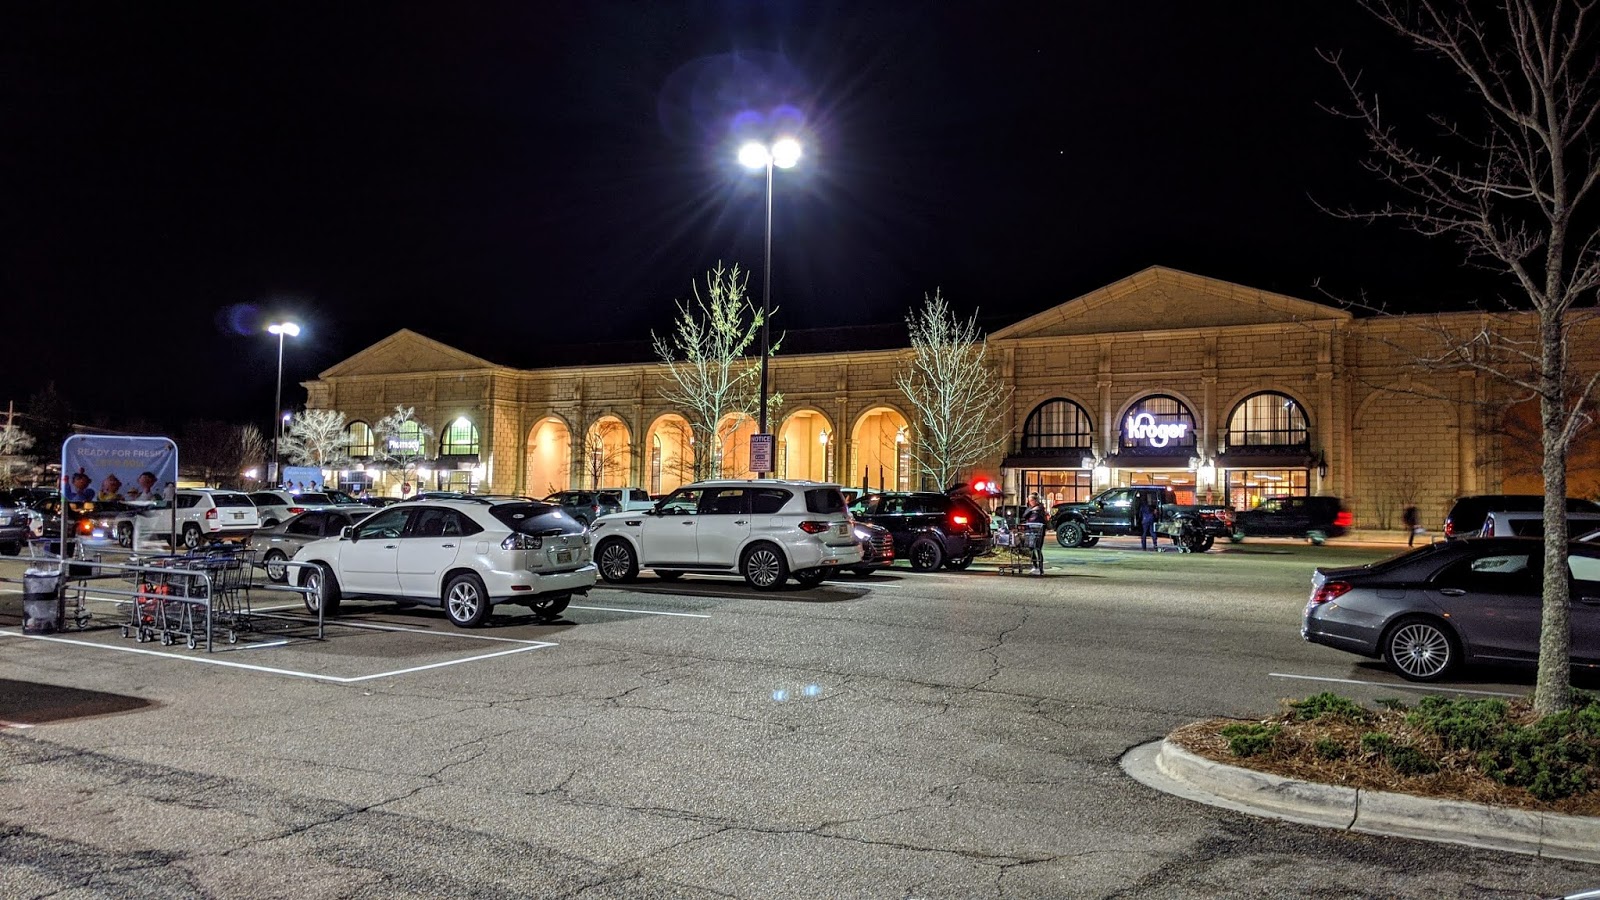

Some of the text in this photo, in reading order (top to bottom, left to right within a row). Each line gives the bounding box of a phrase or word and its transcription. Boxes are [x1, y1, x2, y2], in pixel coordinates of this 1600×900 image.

[1128, 413, 1187, 447] Kroger
[77, 448, 110, 457] READY
[112, 449, 131, 458] FOR
